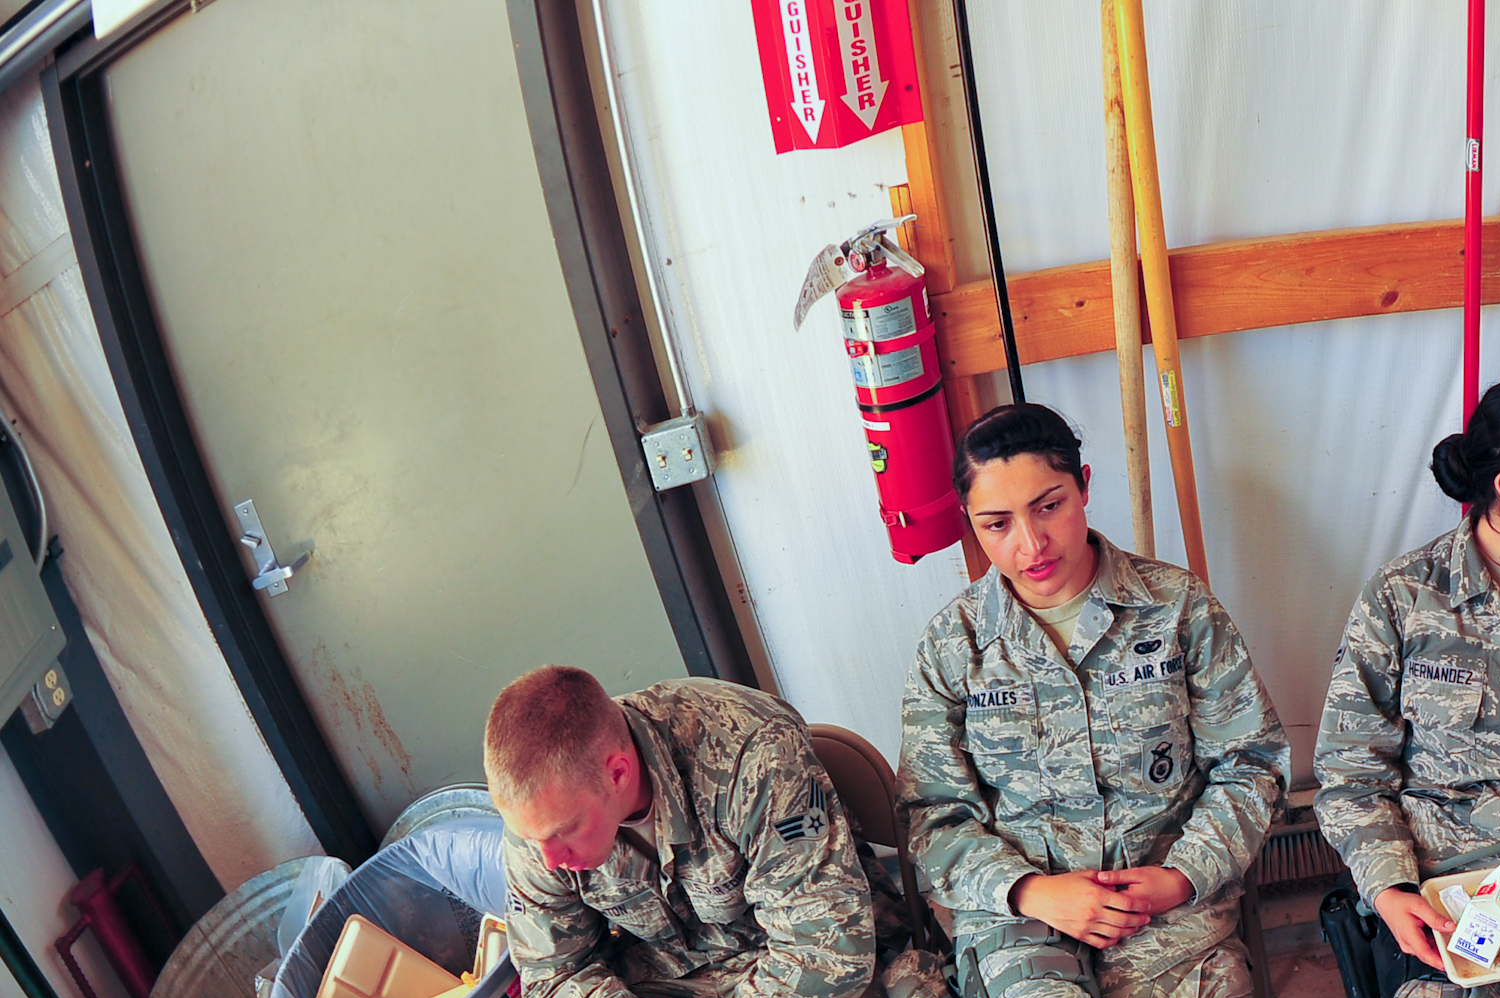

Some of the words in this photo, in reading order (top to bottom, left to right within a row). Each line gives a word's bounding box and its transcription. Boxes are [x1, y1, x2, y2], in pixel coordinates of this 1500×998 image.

[787, 1, 816, 122] GUISHER
[844, 0, 876, 111] UISHER
[1108, 671, 1129, 686] U.S.
[1134, 664, 1155, 682] AIR
[1408, 660, 1474, 686] HERNANDEZ
[969, 691, 1017, 708] ONZALES
